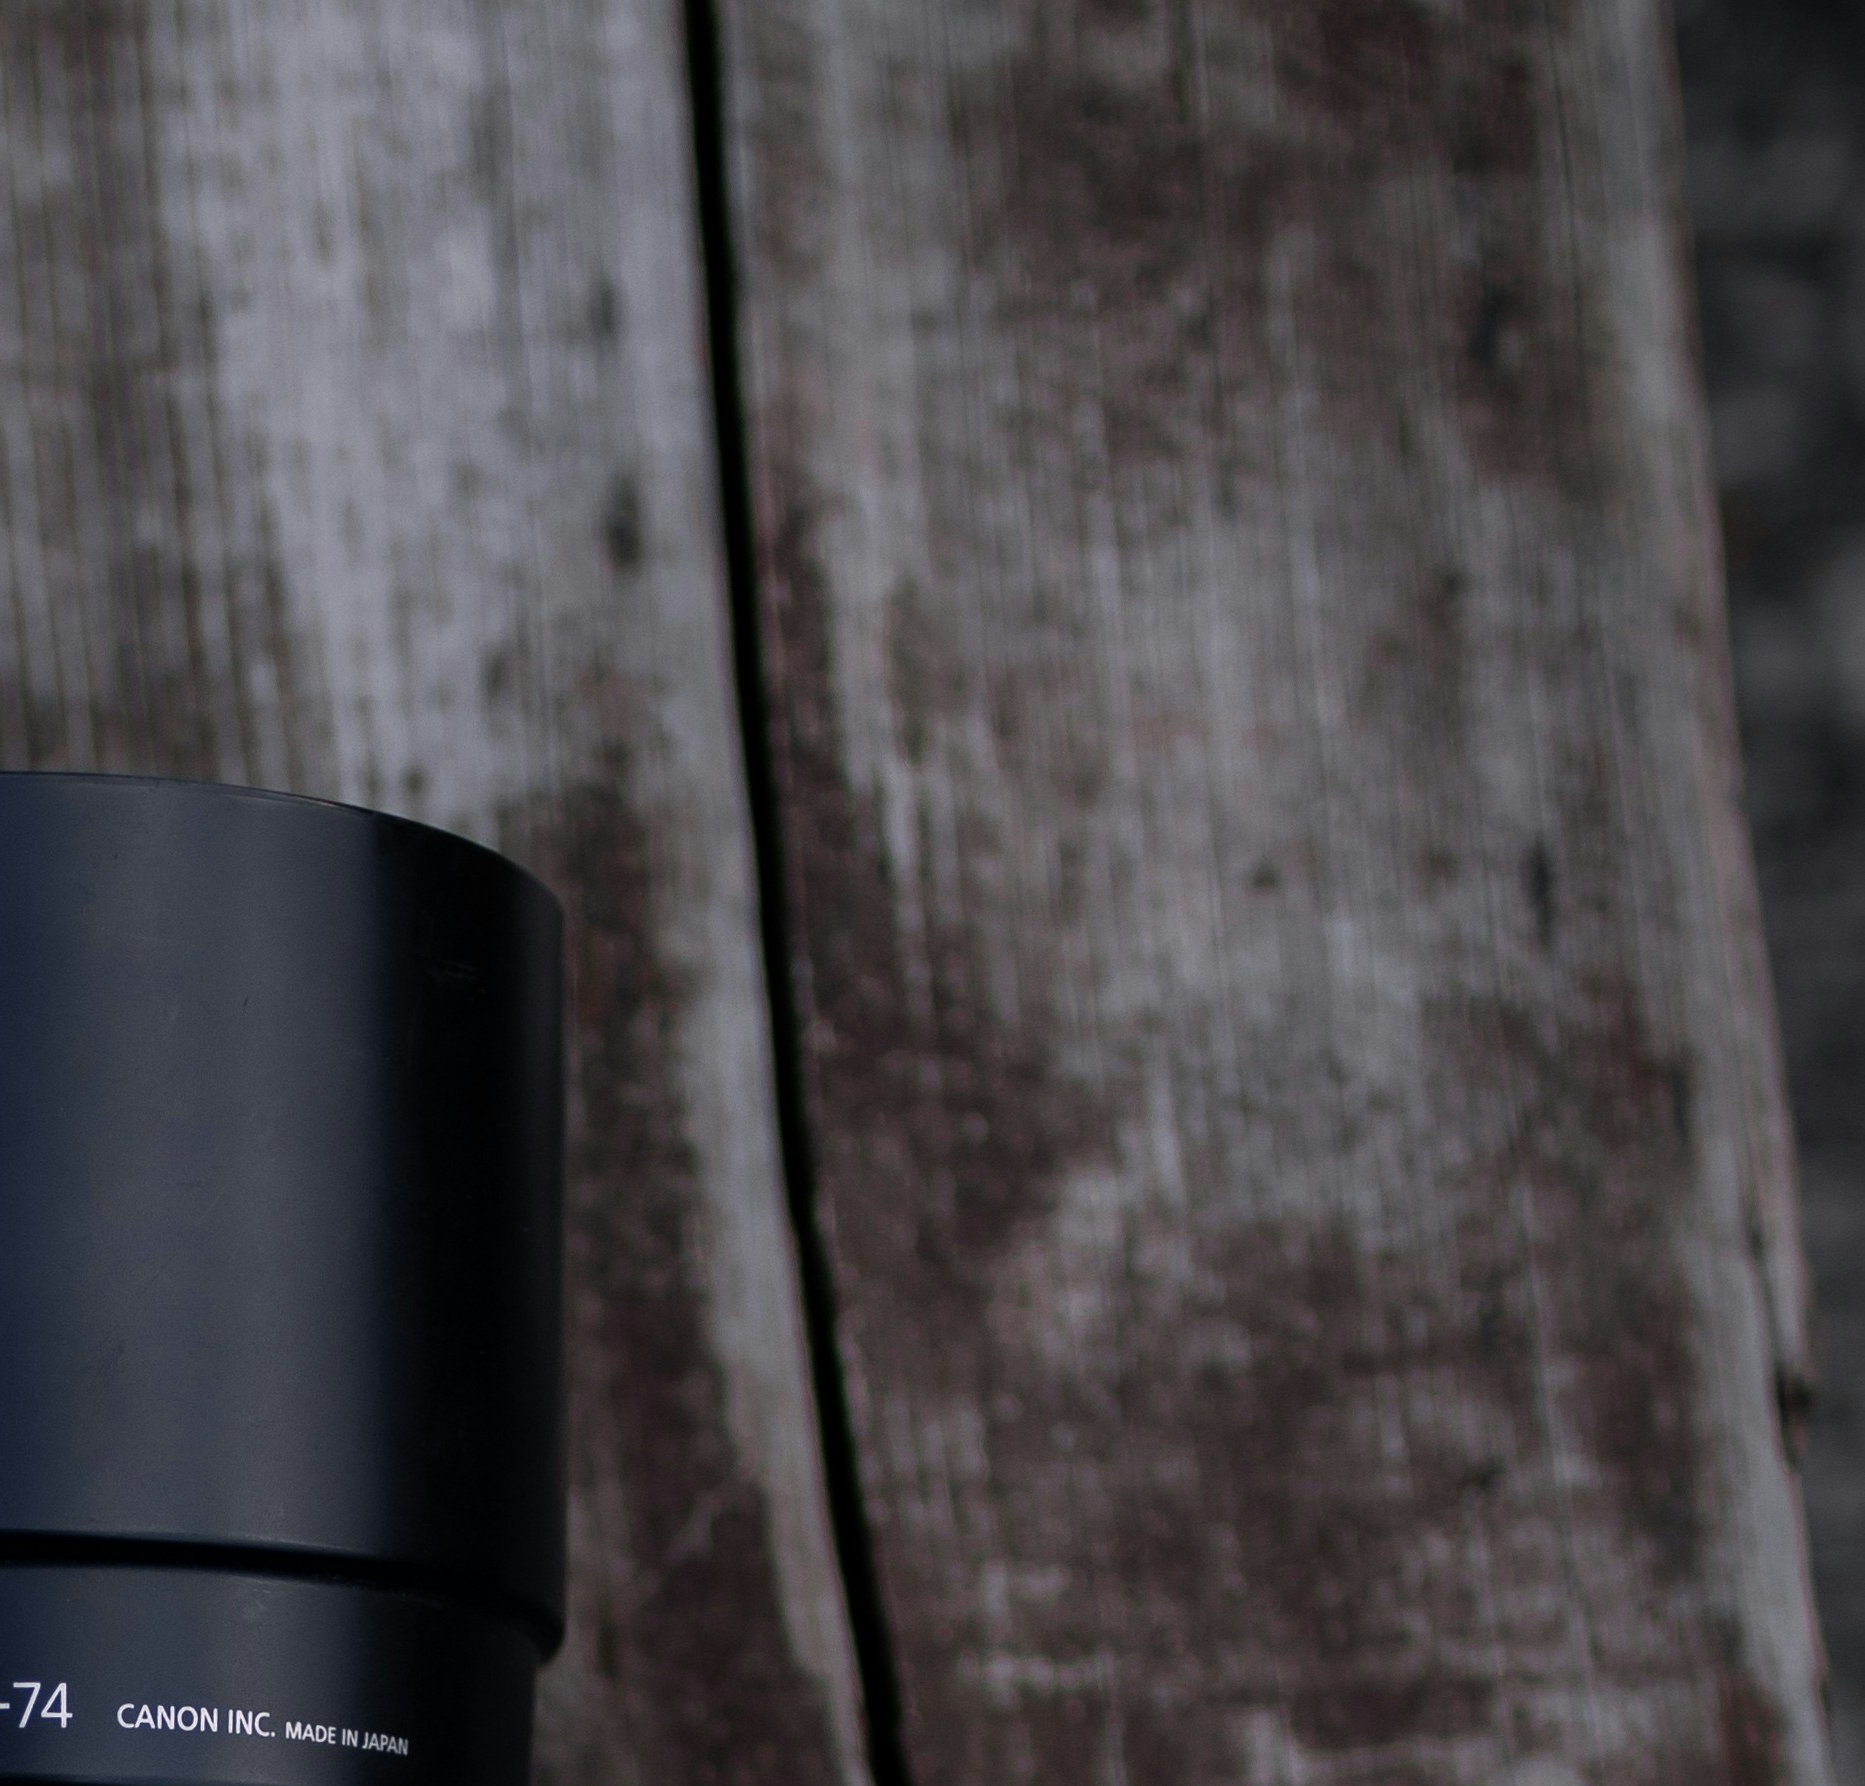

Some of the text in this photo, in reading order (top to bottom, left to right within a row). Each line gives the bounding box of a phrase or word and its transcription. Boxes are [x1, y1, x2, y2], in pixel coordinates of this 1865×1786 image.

[117, 1703, 218, 1732] CANON
[228, 1709, 276, 1737] INC.
[285, 1721, 337, 1744] MADE
[341, 1728, 358, 1748] IN
[362, 1732, 409, 1756] JAPAN
